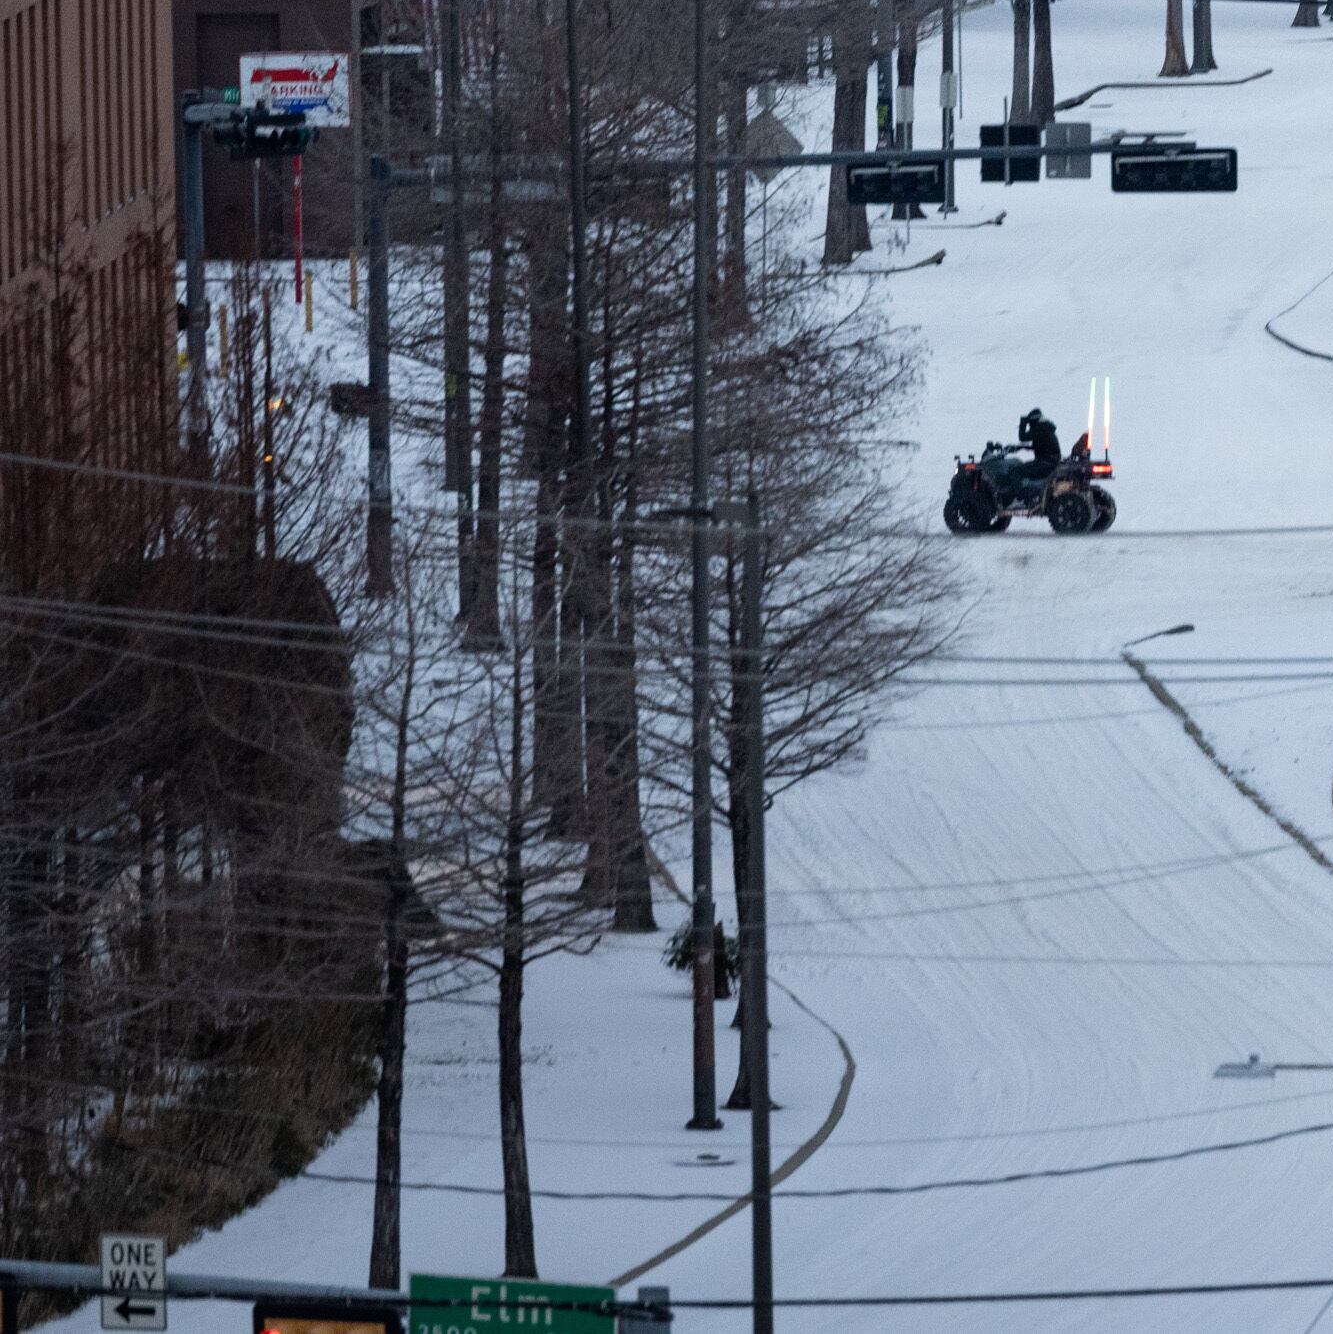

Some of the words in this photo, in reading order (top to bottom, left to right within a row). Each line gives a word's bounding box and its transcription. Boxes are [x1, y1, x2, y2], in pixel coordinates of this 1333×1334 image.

[111, 1241, 156, 1266] ONE
[110, 1268, 157, 1291] WAY
[471, 1284, 552, 1325] Elm
